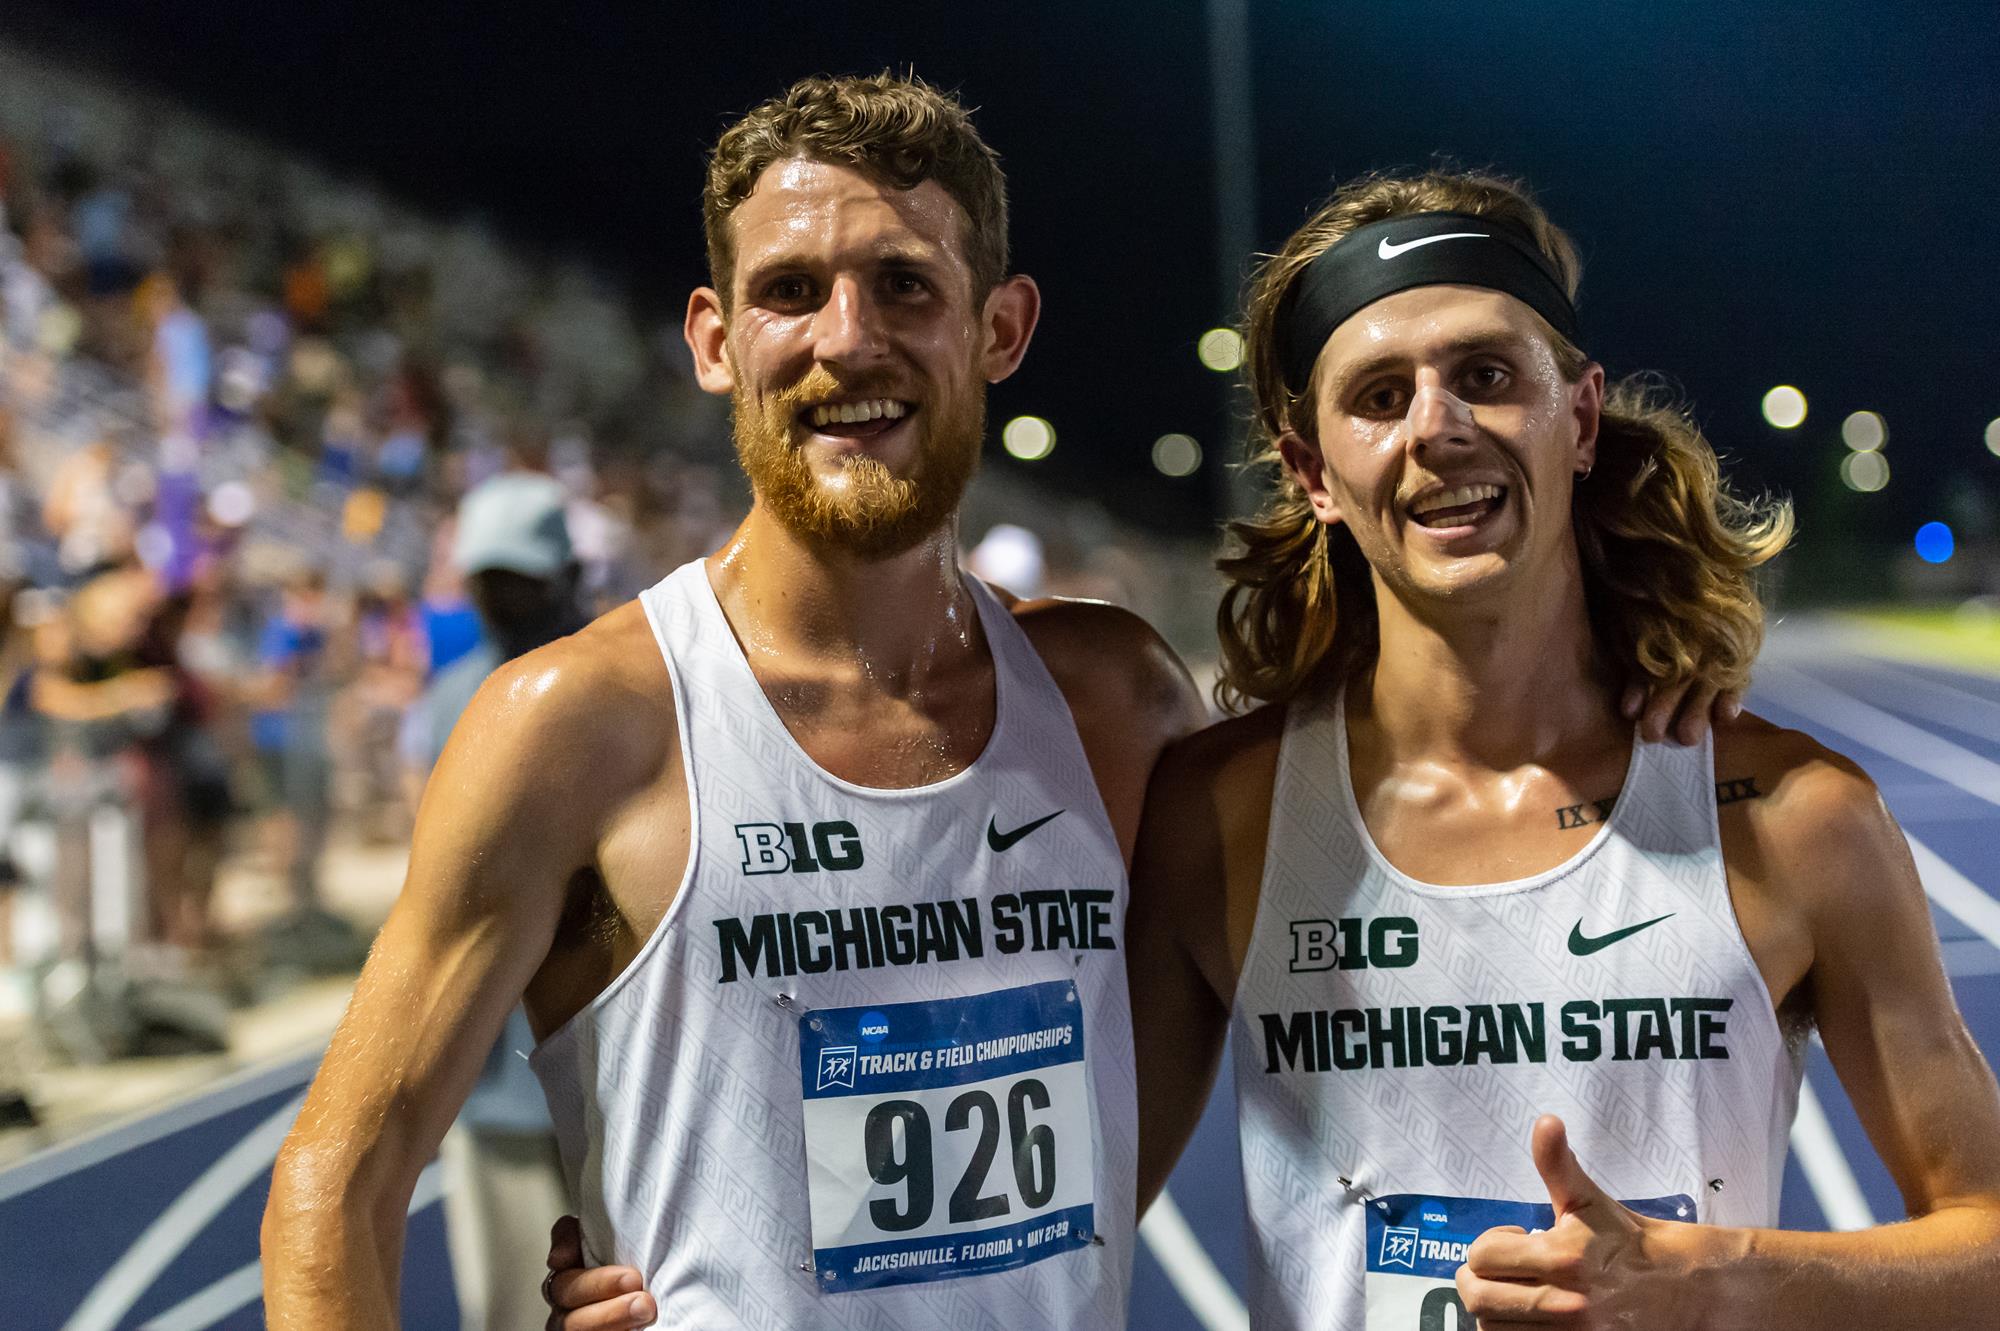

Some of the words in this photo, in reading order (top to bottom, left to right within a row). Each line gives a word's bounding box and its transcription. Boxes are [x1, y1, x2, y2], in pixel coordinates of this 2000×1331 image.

[712, 898, 984, 984] MICHIGAN
[992, 889, 1117, 954] STATE
[860, 1052, 917, 1075] TRACK
[920, 1051, 933, 1070] &
[935, 1045, 974, 1069] FIELD
[976, 1025, 1073, 1062] CHAMPIONSHIPS
[862, 1025, 889, 1036] NCAA
[1258, 1002, 1547, 1074] MICHIGAN
[1561, 998, 1734, 1062] STATE
[864, 1078, 1057, 1232] 926
[1424, 1213, 1448, 1223] NCAA
[853, 1246, 957, 1274] JACKSONVILLE,
[961, 1238, 1013, 1261] FLORIDA
[1027, 1229, 1044, 1249] MAY
[1045, 1221, 1069, 1242] 27-29
